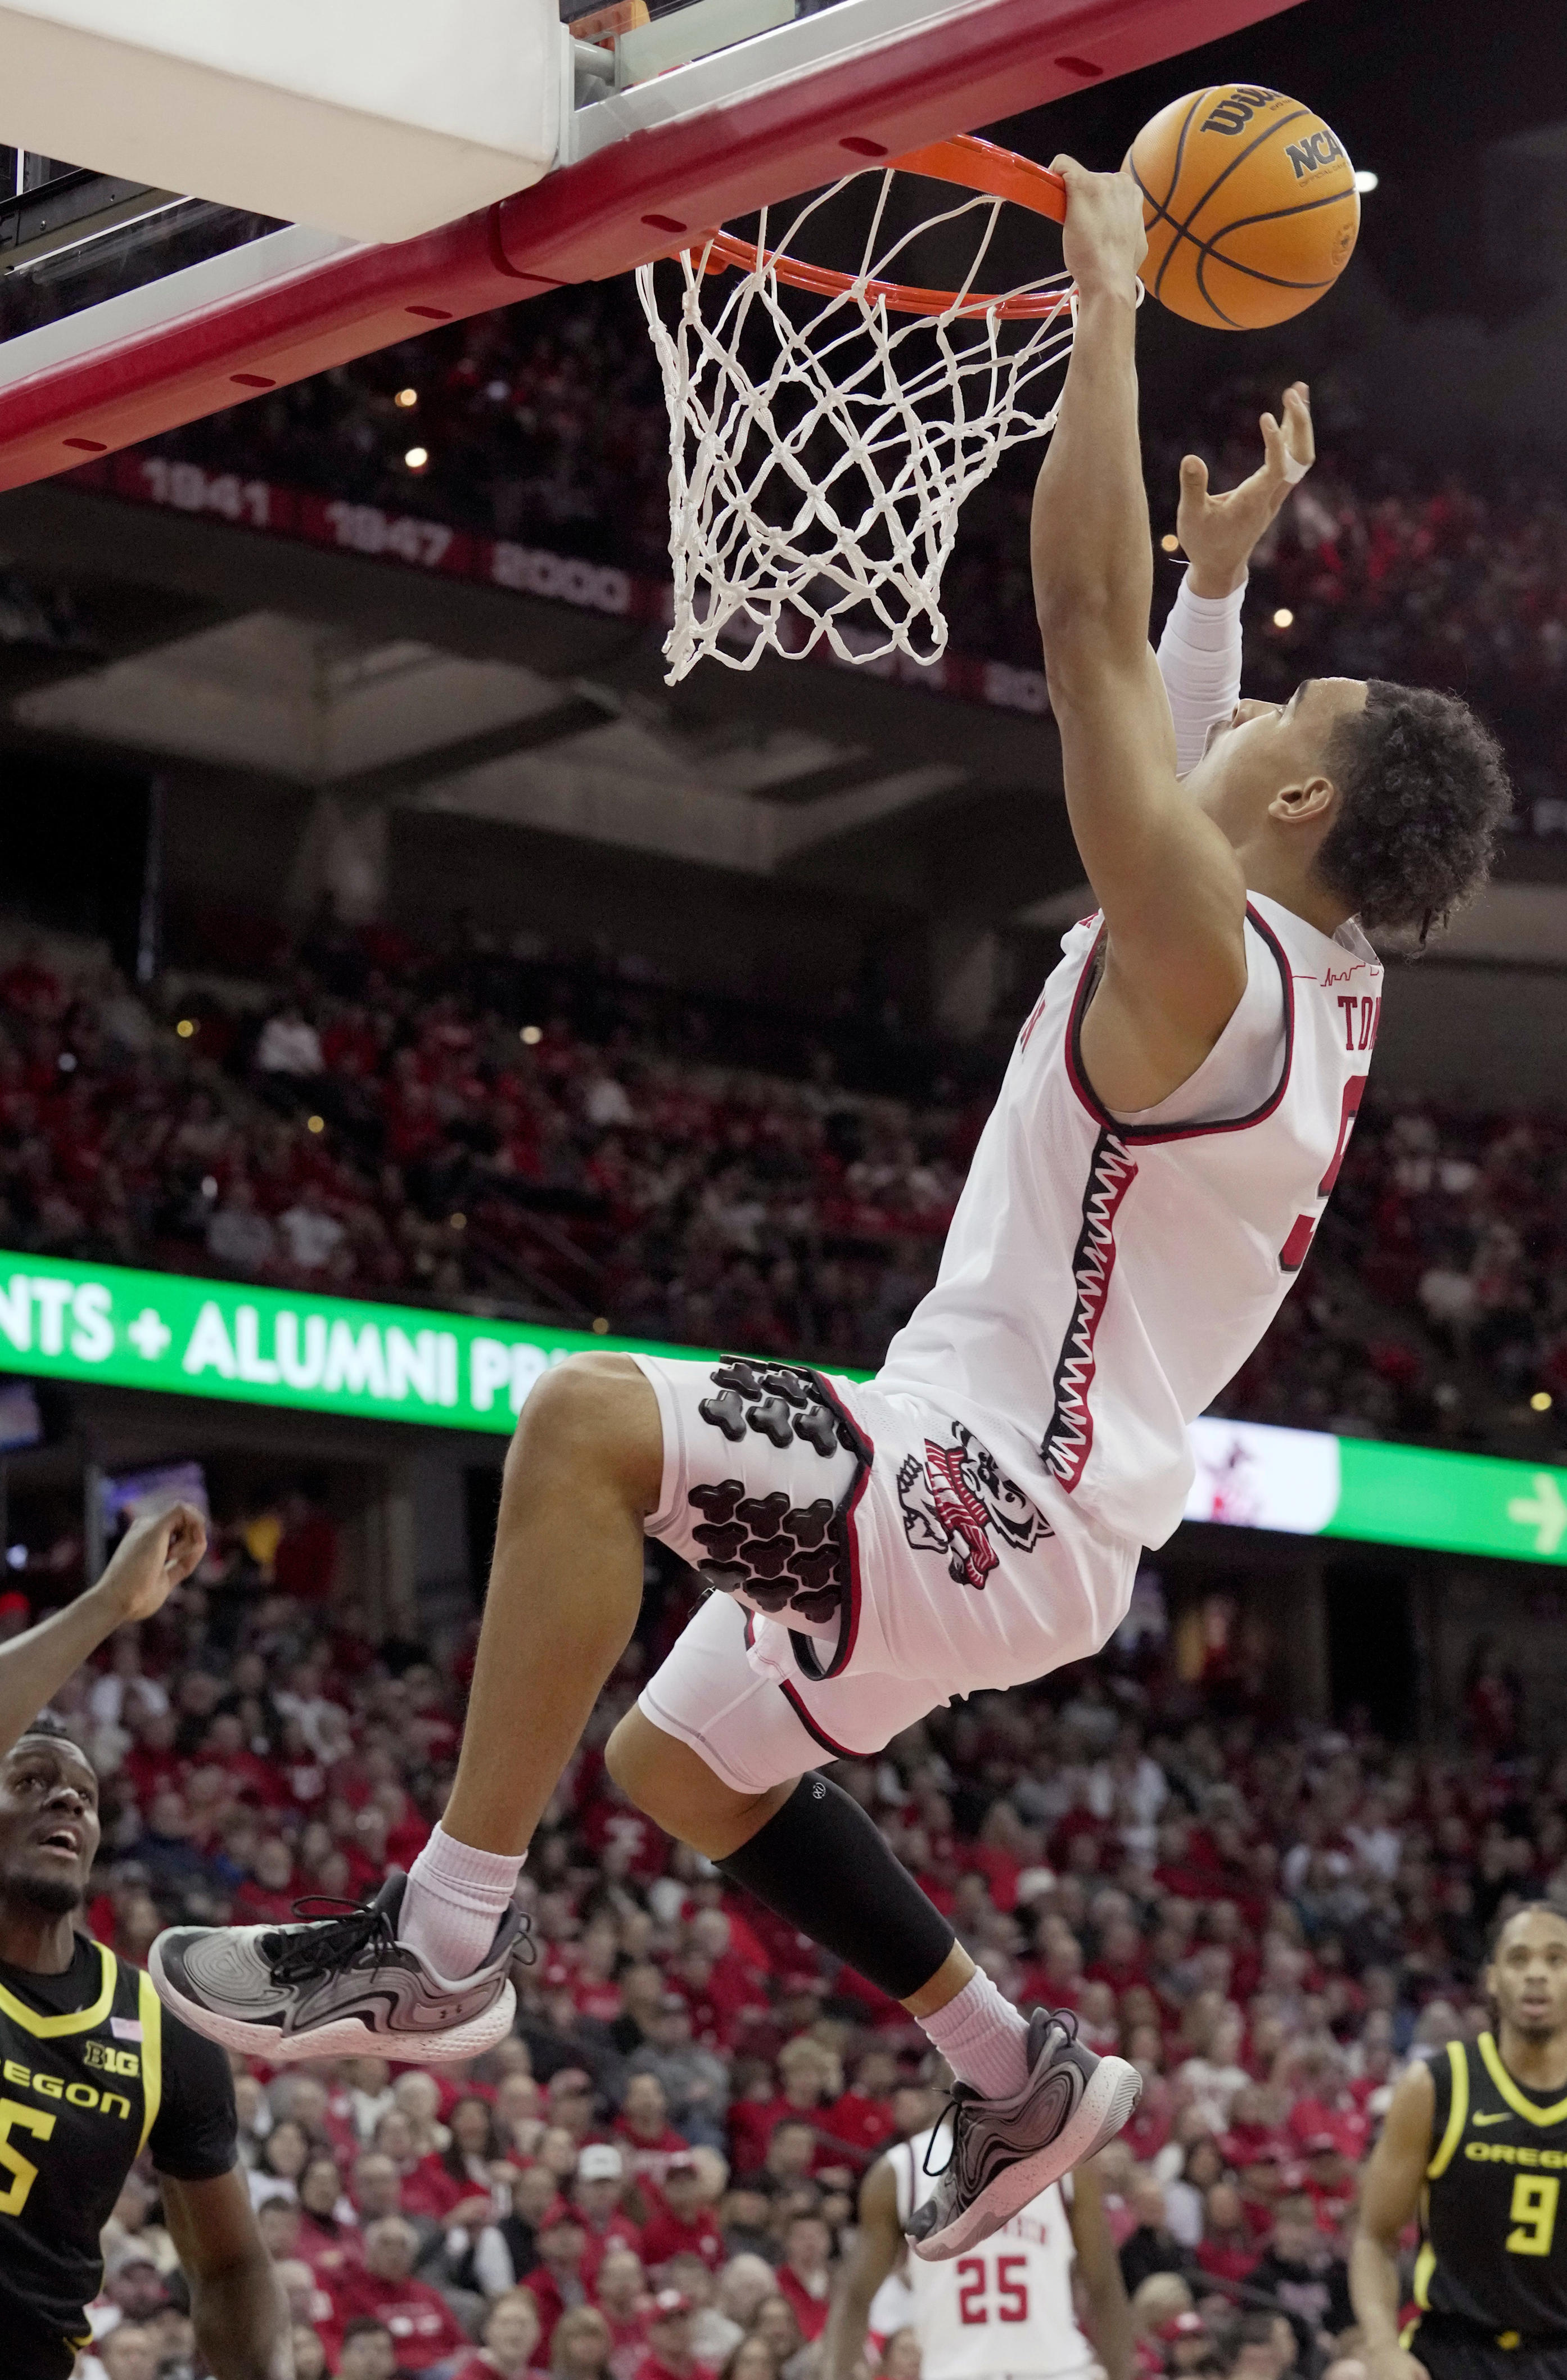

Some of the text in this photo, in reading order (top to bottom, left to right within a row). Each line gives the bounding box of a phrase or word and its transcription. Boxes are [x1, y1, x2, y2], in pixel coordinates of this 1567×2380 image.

[182, 1300, 459, 1408] ALUMNI
[1505, 2173, 1560, 2258] 9
[957, 2255, 1029, 2325] 25
